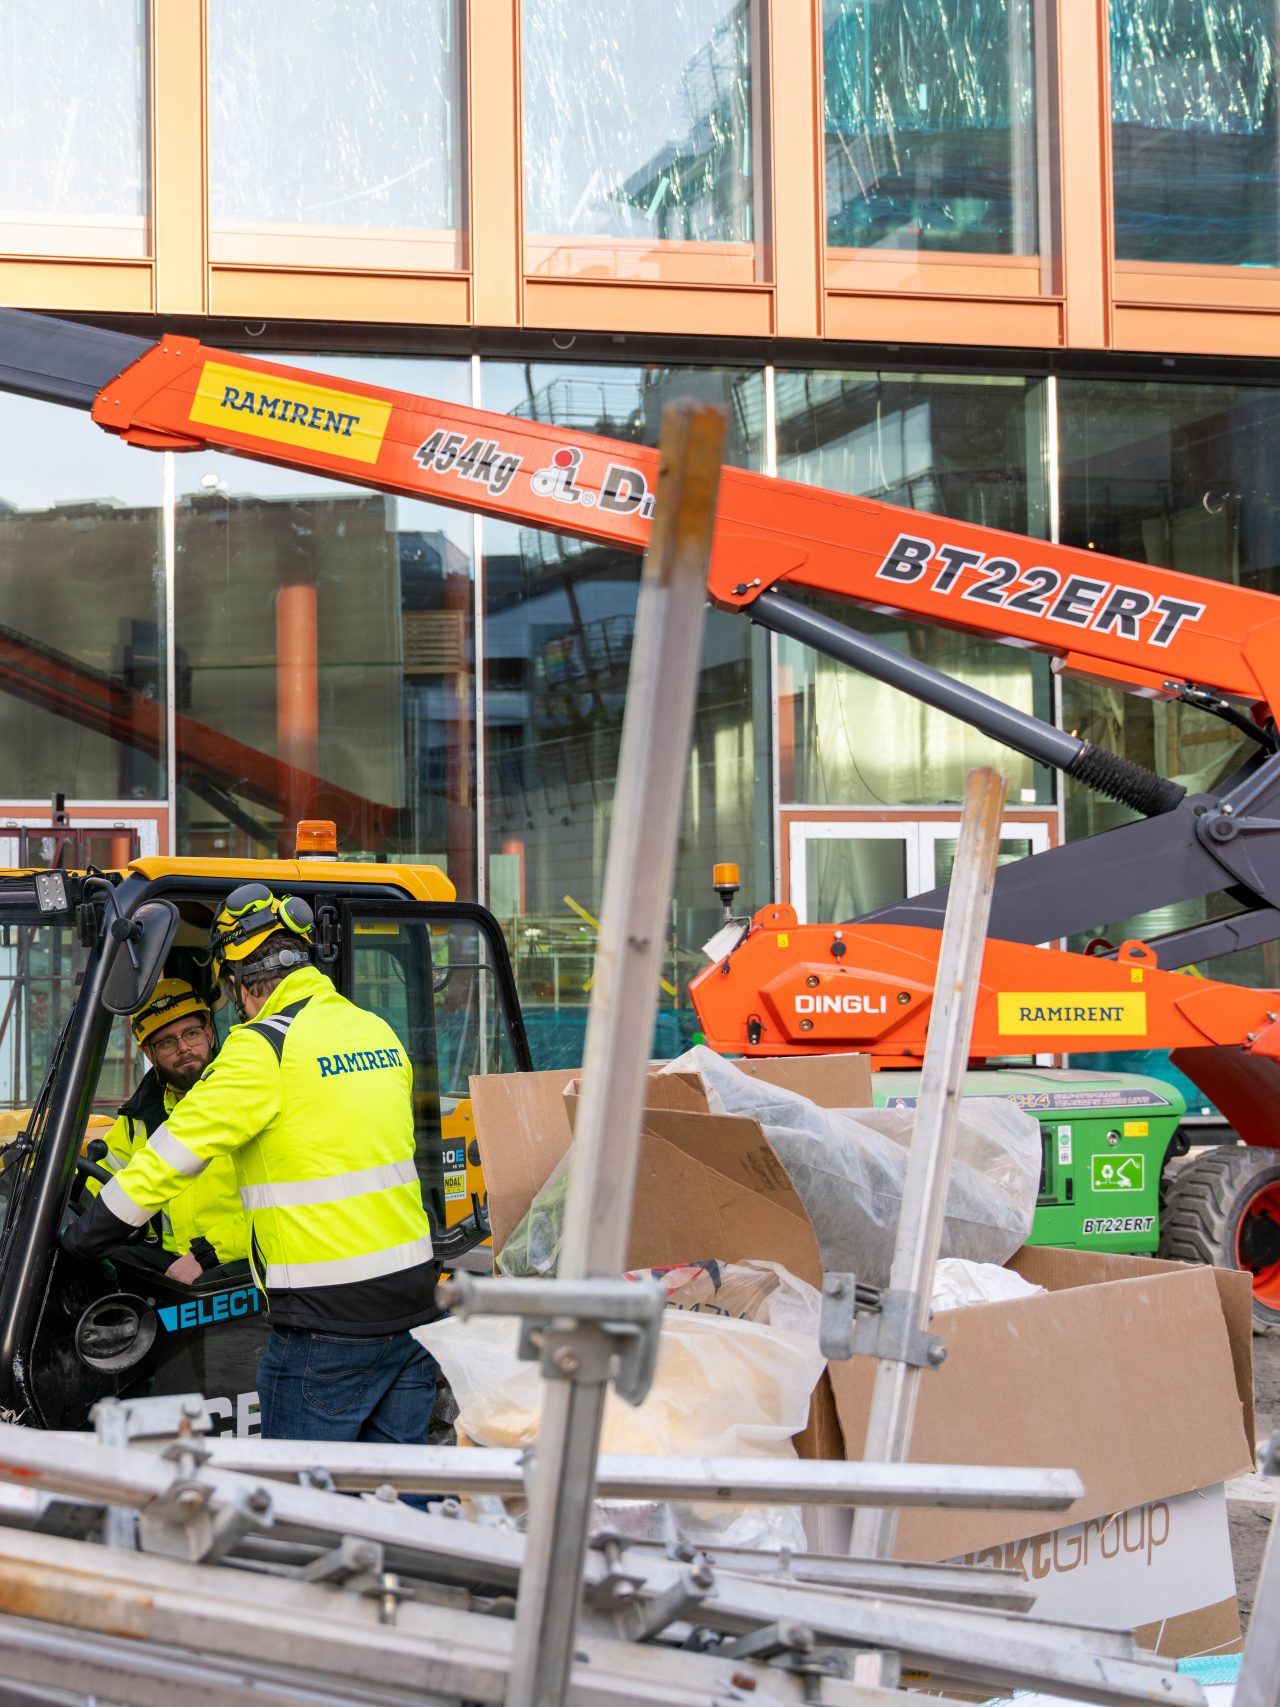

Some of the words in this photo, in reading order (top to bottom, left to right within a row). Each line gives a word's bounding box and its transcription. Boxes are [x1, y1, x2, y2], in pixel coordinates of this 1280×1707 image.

[220, 386, 360, 437] RAMIRENT
[413, 429, 524, 496] 454kg
[875, 533, 1207, 648] BT22ERT
[795, 994, 887, 1014] DINGLI
[1019, 1007, 1124, 1022] RAMIRENT
[317, 1048, 402, 1078] RAMIRENT
[1083, 1216, 1155, 1235] BT22ERT
